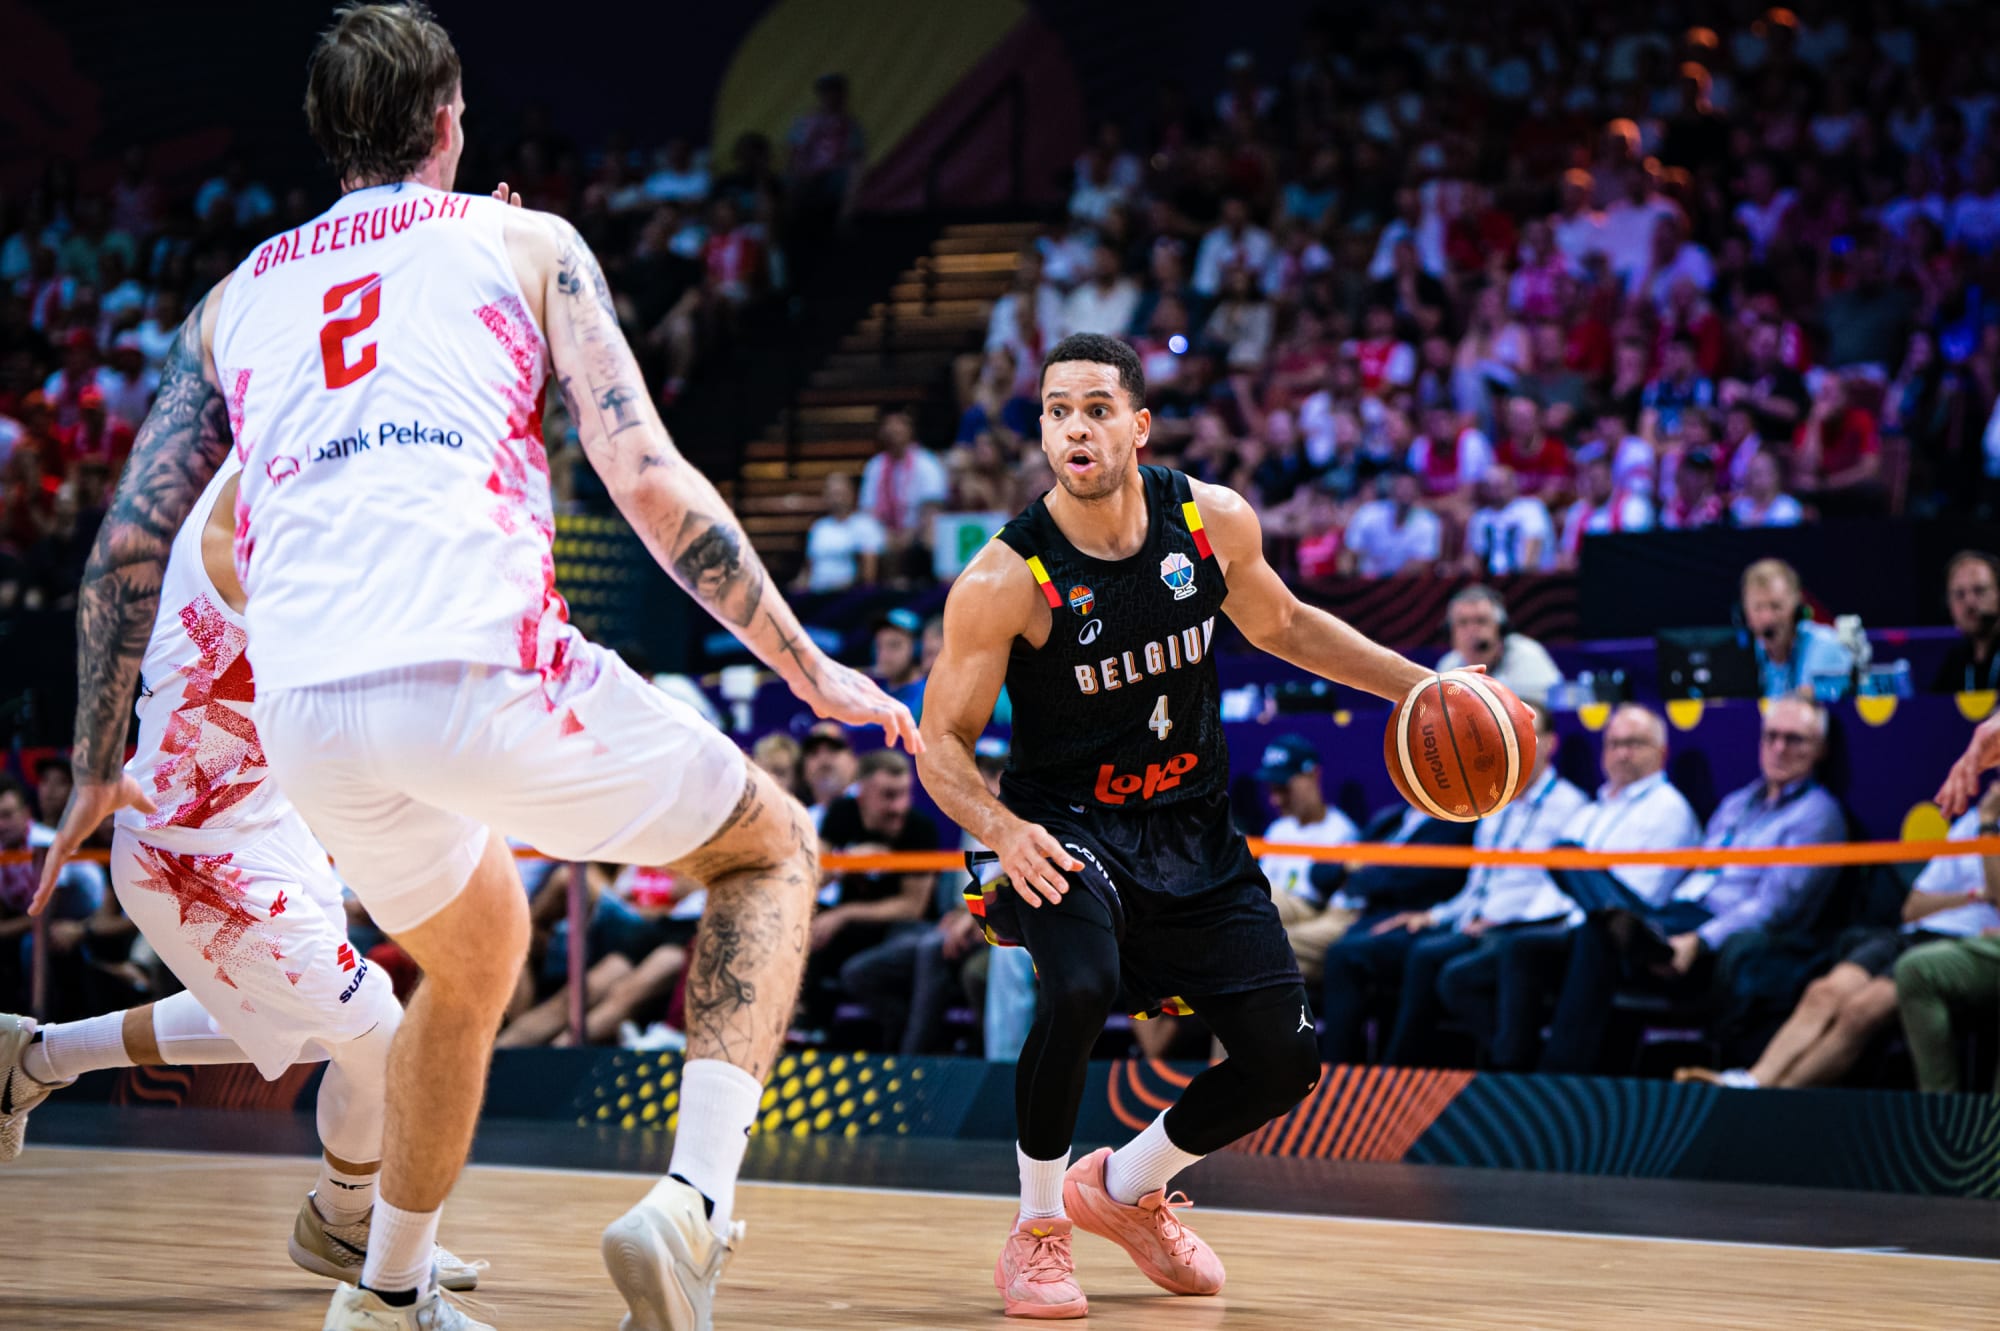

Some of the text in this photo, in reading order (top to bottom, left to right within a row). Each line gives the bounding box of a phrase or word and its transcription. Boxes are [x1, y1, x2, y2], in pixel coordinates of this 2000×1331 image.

[254, 194, 471, 278] BALCEROWSKI
[320, 272, 381, 390] 2
[378, 420, 463, 449] Pekao
[1149, 695, 1173, 740] 4
[1422, 724, 1451, 789] molten
